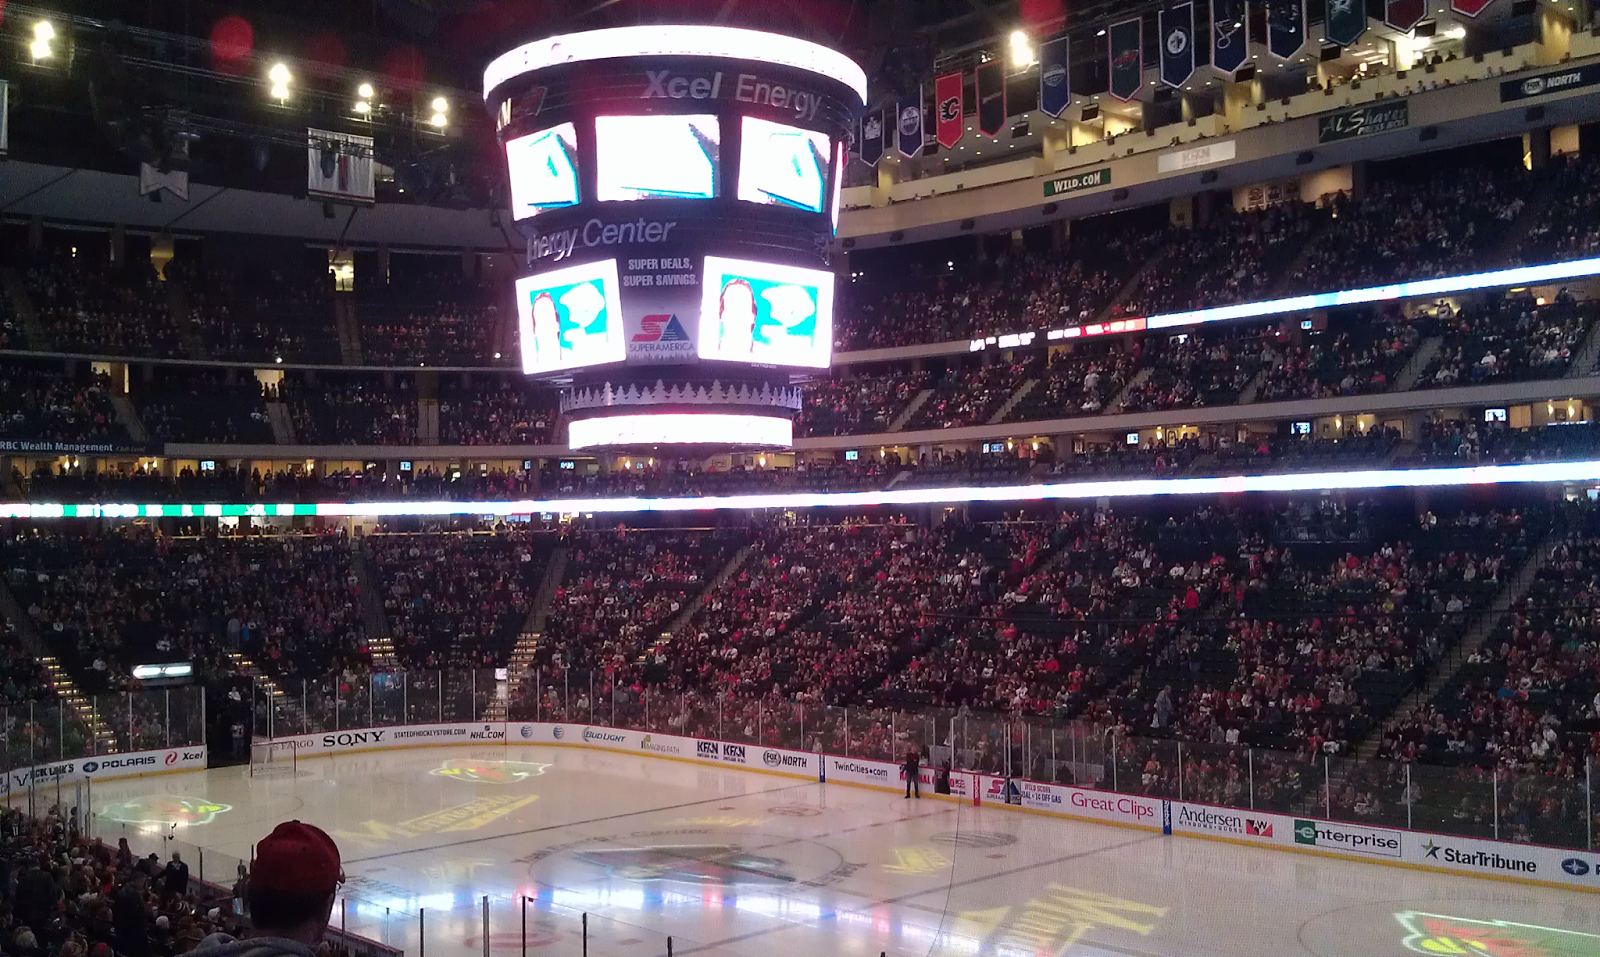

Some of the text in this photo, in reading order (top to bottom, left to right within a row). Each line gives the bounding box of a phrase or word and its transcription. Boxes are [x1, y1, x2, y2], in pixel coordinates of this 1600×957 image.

[1547, 72, 1581, 88] NORTH
[640, 69, 822, 121] Xcel Energy
[1053, 171, 1101, 193] WILD.COM
[583, 217, 677, 247] Center
[628, 257, 693, 270] SUPER DEALS,
[623, 274, 699, 287] SUPER SAVINGS.
[629, 342, 695, 352] SUPERAMERICA
[0, 441, 18, 451] RBC
[20, 442, 53, 452] Wealth
[55, 442, 113, 453] Management
[322, 730, 385, 747] SONY
[394, 728, 467, 739] STATEOFHOCKEYSTORE.COM
[470, 731, 504, 740] NHL.COM
[603, 733, 626, 742] LIGHT
[666, 746, 680, 754] PATH
[697, 740, 719, 754] KFAN
[723, 744, 746, 758] KFAN
[102, 756, 157, 769] POLARIS
[182, 751, 204, 761] Xcel
[782, 755, 807, 768] NORTH
[1042, 793, 1051, 802] OFF
[1051, 795, 1062, 804] GAS
[1071, 792, 1155, 820] Great Clips
[1179, 805, 1241, 828] Andersen
[1300, 826, 1399, 849] enterprise
[1444, 847, 1537, 873] StarTribune
